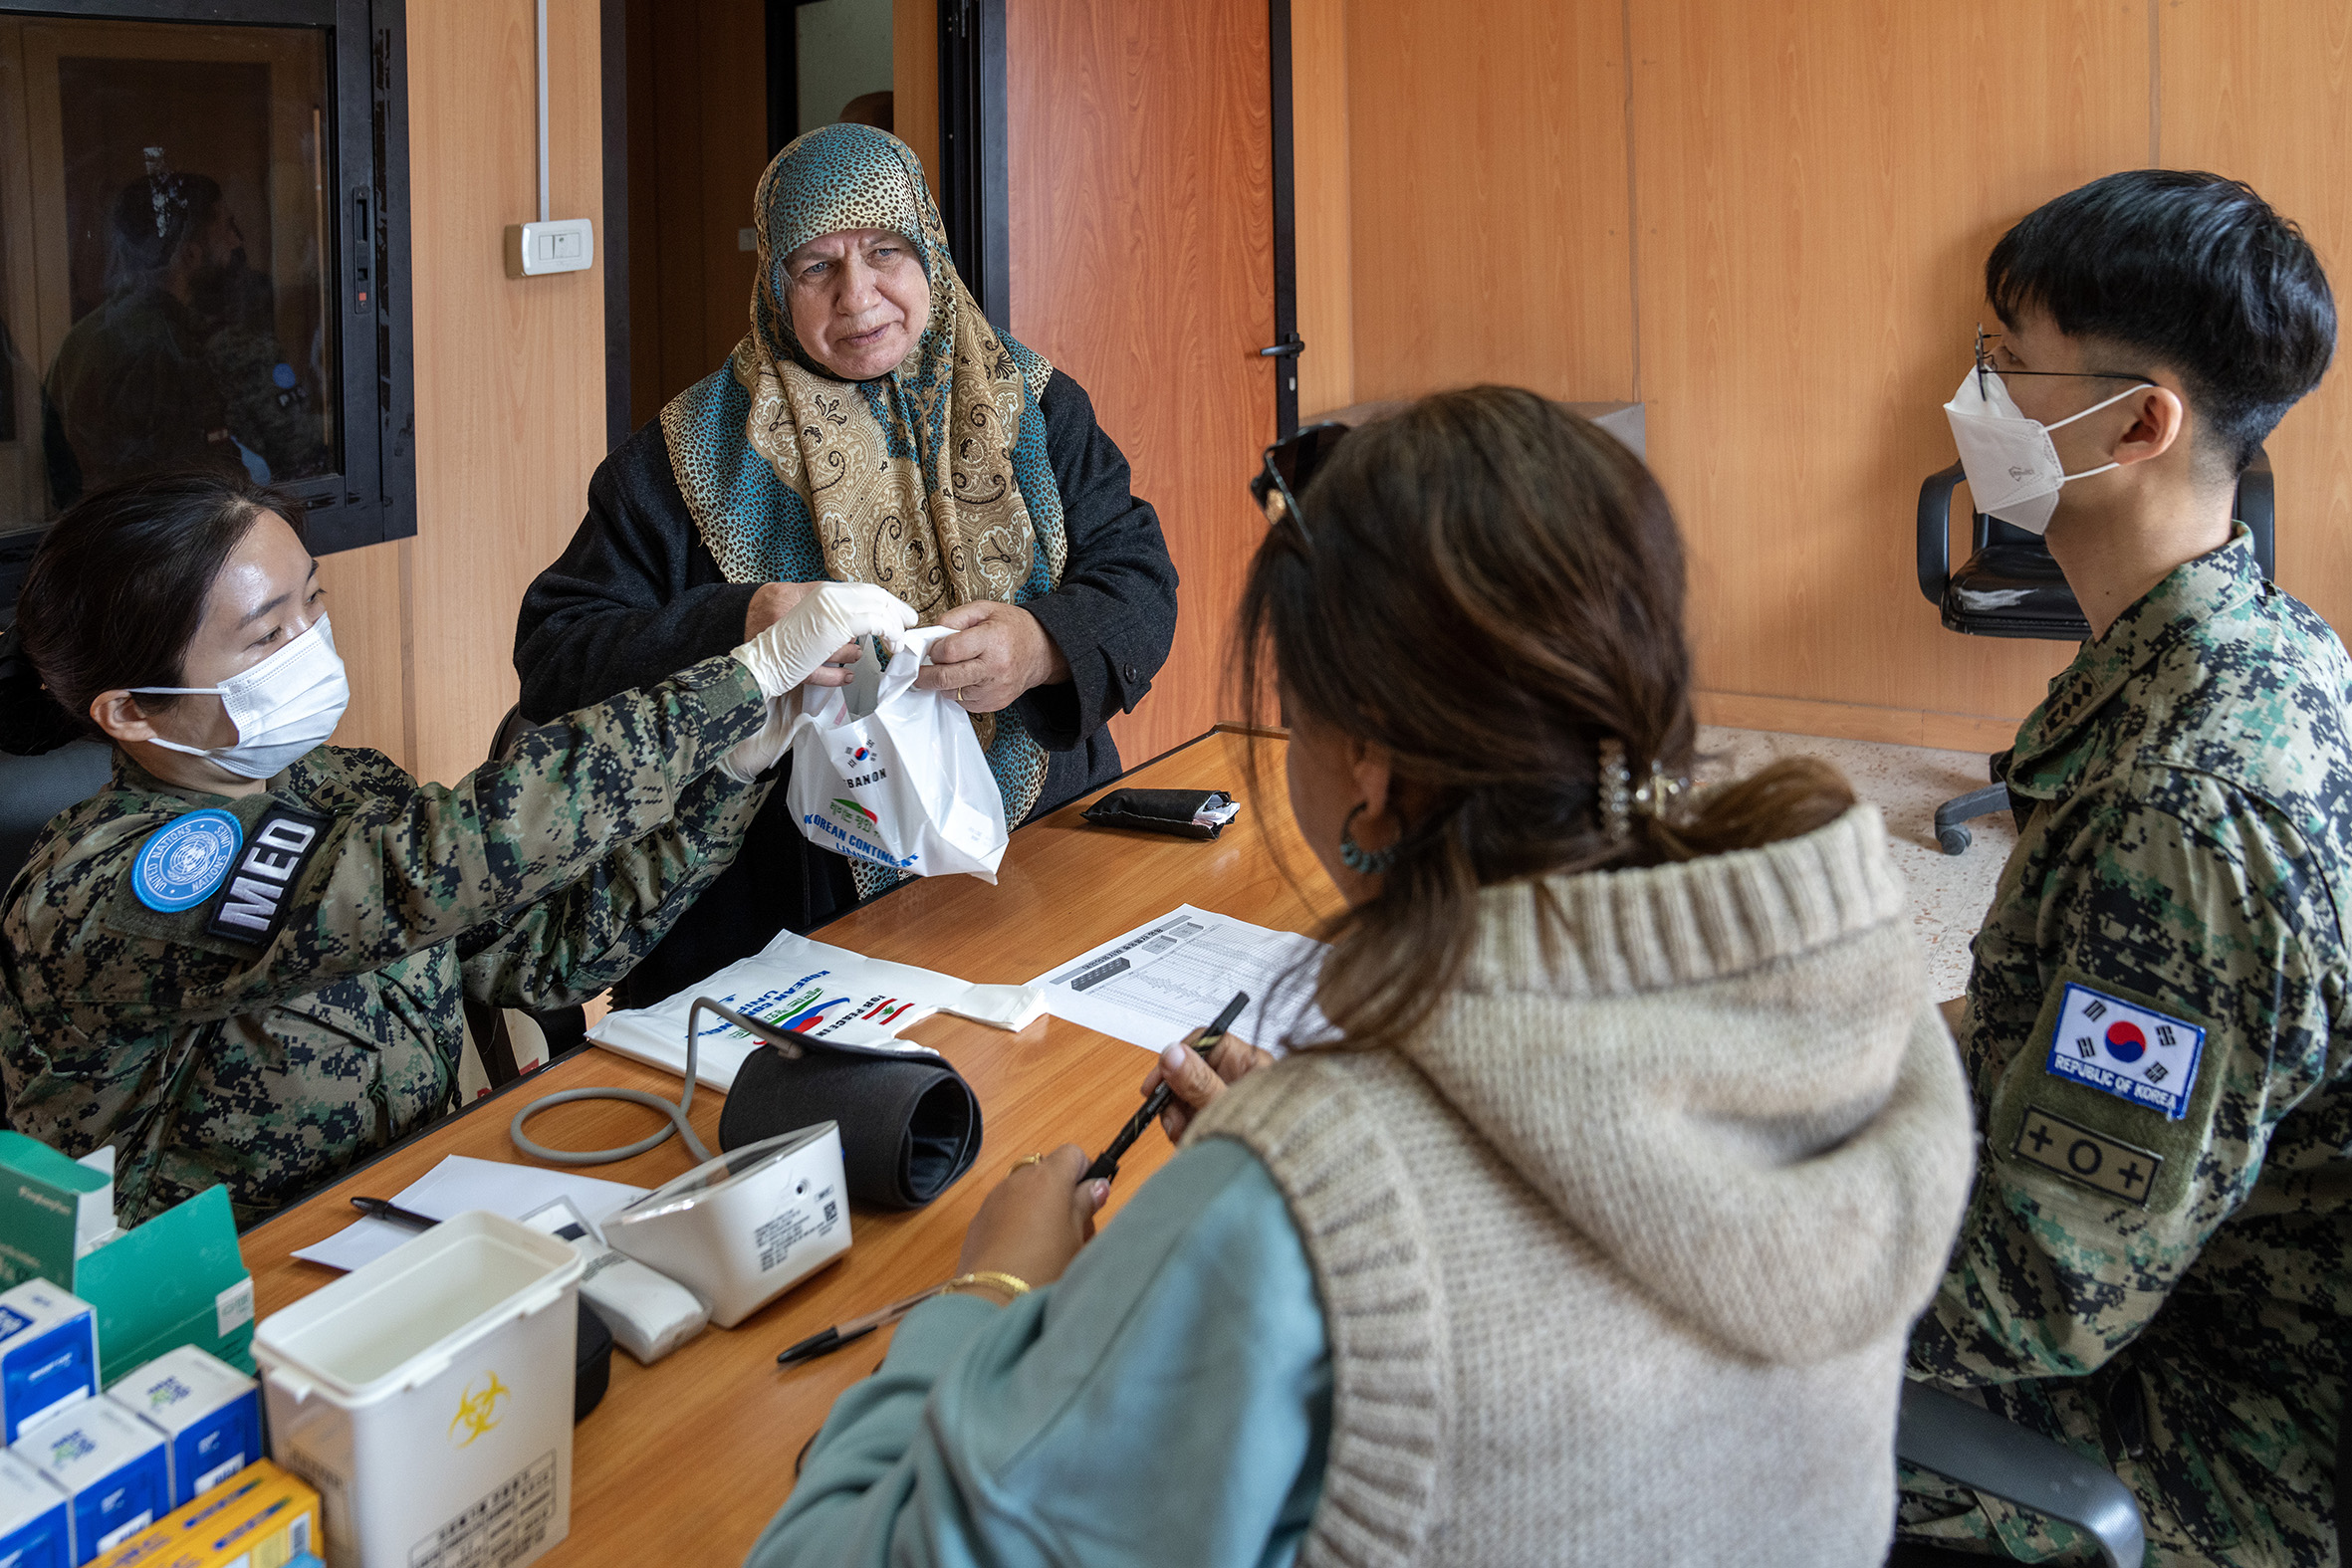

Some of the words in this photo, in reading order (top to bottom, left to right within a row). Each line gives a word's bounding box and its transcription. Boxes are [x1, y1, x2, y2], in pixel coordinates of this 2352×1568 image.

[843, 768, 887, 788] BANON
[151, 825, 192, 860] NATIONS
[804, 813, 846, 842] KOREAN
[192, 854, 227, 892] NATIONS
[214, 825, 232, 849] UNIES
[147, 863, 167, 892] UNITED
[218, 818, 317, 932] MED
[774, 970, 830, 1003] KOREAN
[862, 995, 886, 1008] FOR
[828, 1008, 865, 1030] PEACE
[2054, 1054, 2115, 1087] REPUBLIC
[2115, 1076, 2133, 1093] OF
[2133, 1083, 2177, 1110] KOREA
